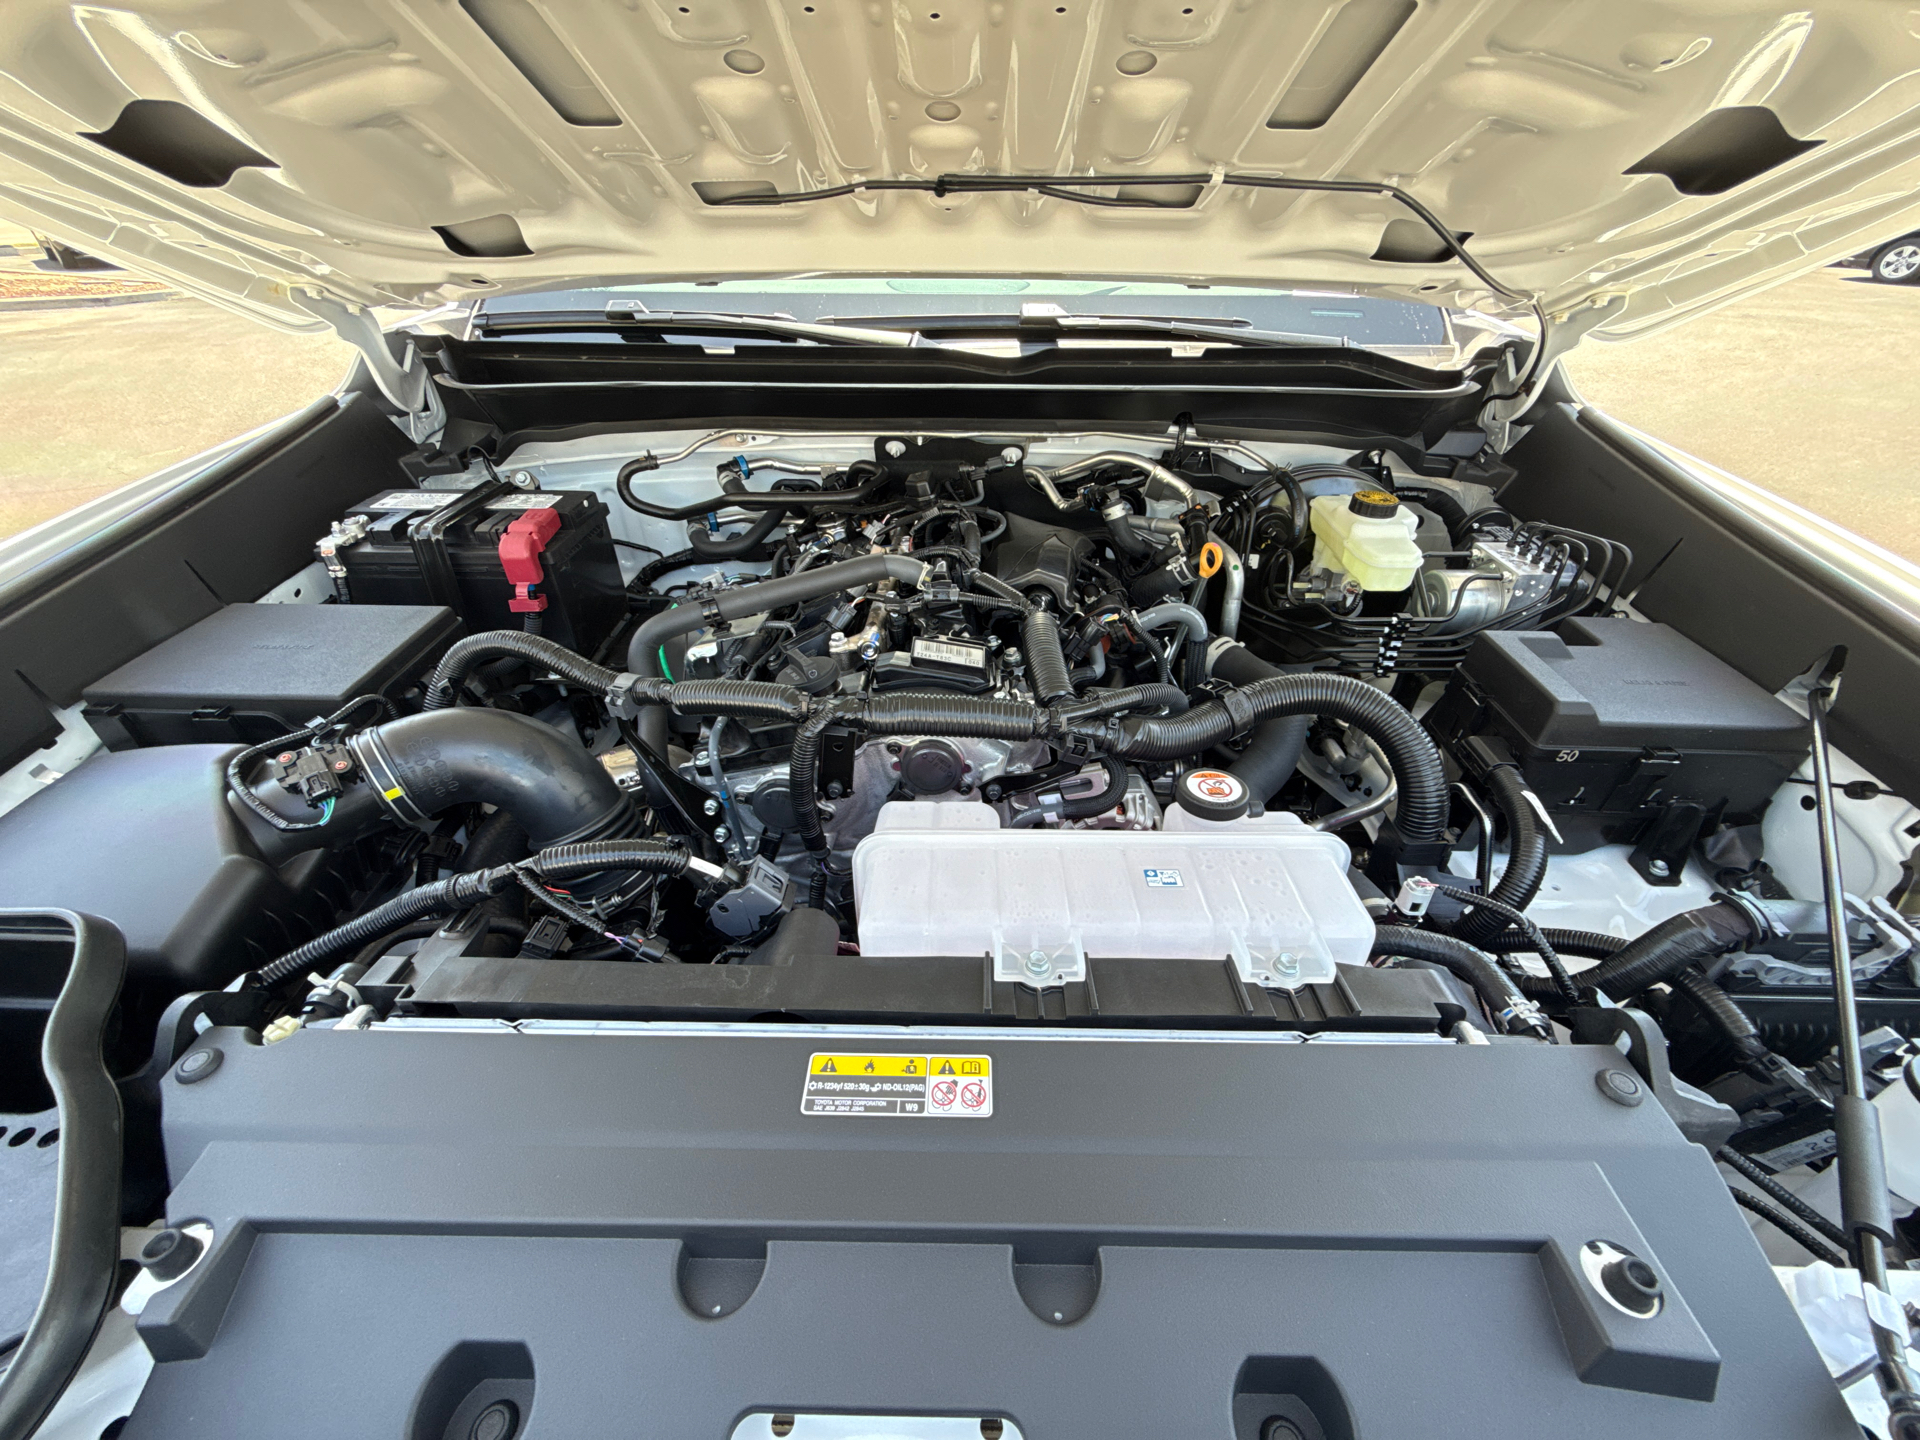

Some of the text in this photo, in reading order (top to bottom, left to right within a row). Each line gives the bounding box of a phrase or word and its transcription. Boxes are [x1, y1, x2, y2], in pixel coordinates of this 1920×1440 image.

[1555, 749, 1580, 763] 50
[817, 1081, 843, 1092] R-1234yf
[905, 1102, 919, 1112] W9
